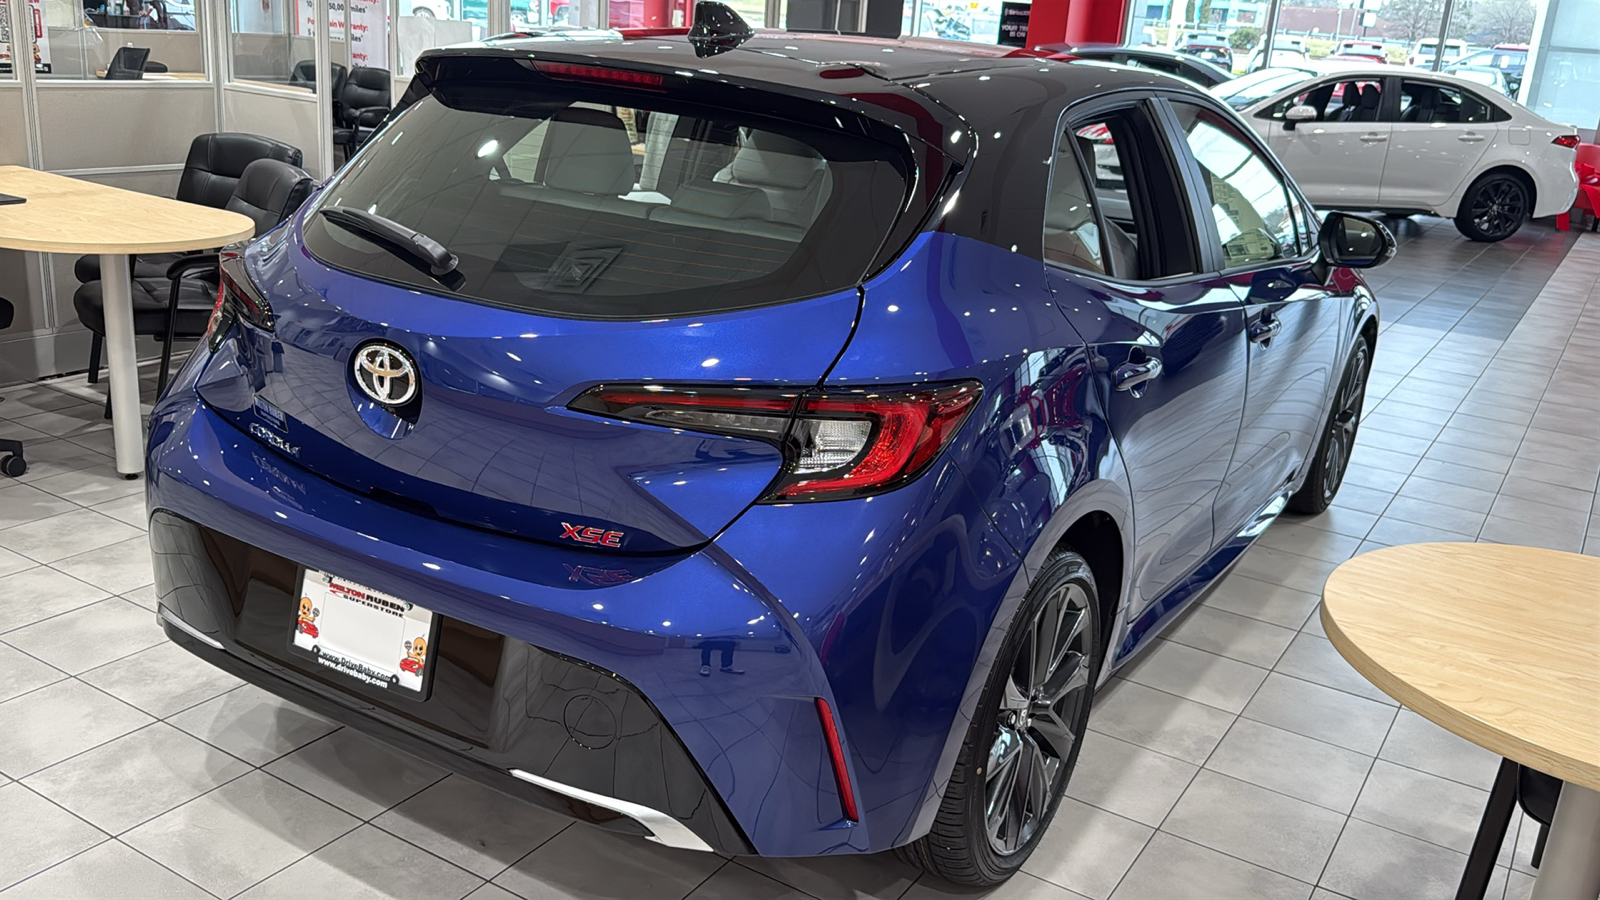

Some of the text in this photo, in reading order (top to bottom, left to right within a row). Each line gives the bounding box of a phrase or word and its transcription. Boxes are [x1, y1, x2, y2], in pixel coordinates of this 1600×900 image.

[559, 521, 624, 548] XSE
[329, 582, 365, 600] MILTON
[365, 594, 405, 613] RUBEN
[343, 594, 404, 618] SUPERSTORE
[318, 656, 388, 689] www.drivebaby.com
[322, 651, 391, 681] www.DriveBaby.com
